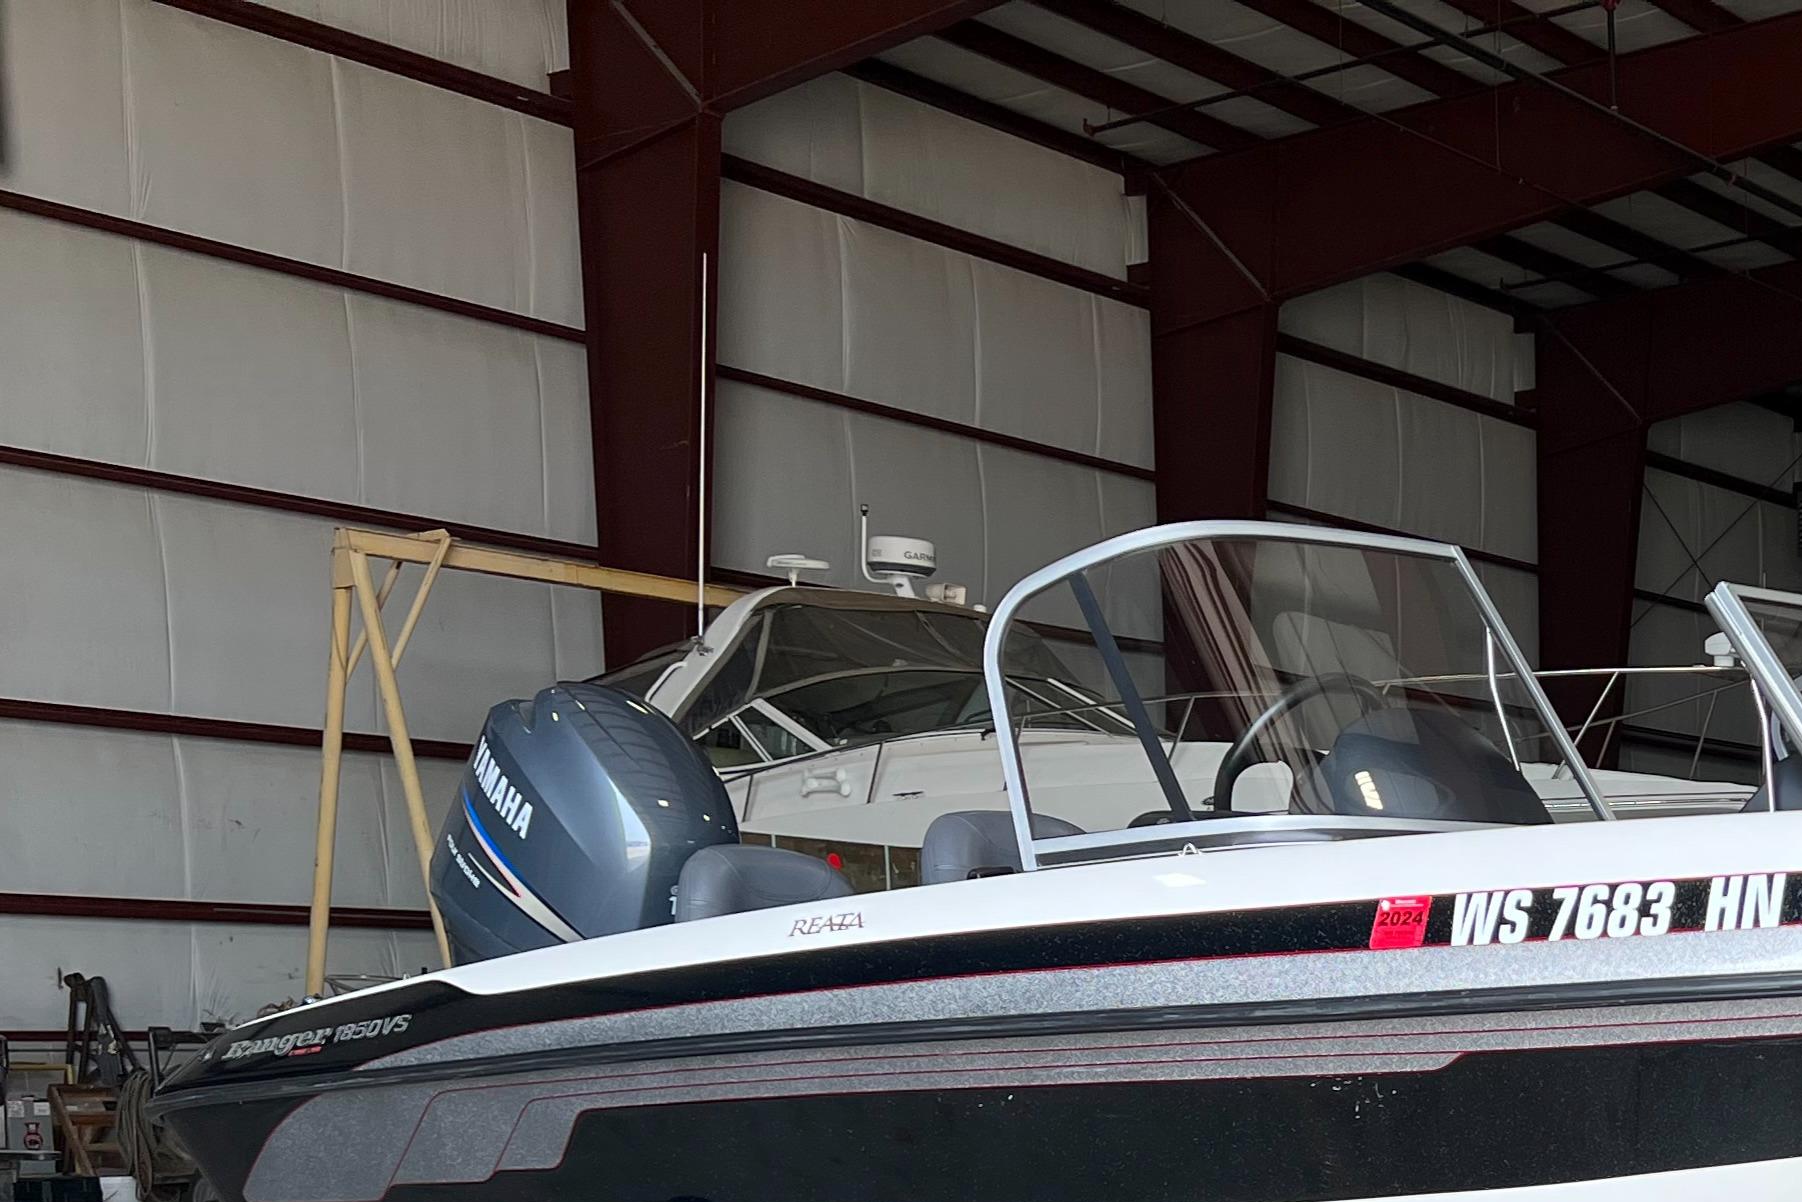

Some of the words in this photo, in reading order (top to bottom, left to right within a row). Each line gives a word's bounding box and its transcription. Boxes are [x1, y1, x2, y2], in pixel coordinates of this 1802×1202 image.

[903, 550, 936, 561] GARM
[473, 734, 534, 840] YAMAHA
[788, 911, 865, 937] REATA
[1378, 910, 1424, 927] 2024
[1450, 888, 1533, 947] WS
[1548, 881, 1675, 942] 7683
[1704, 872, 1787, 932] HN
[220, 1026, 333, 1061] Ranger
